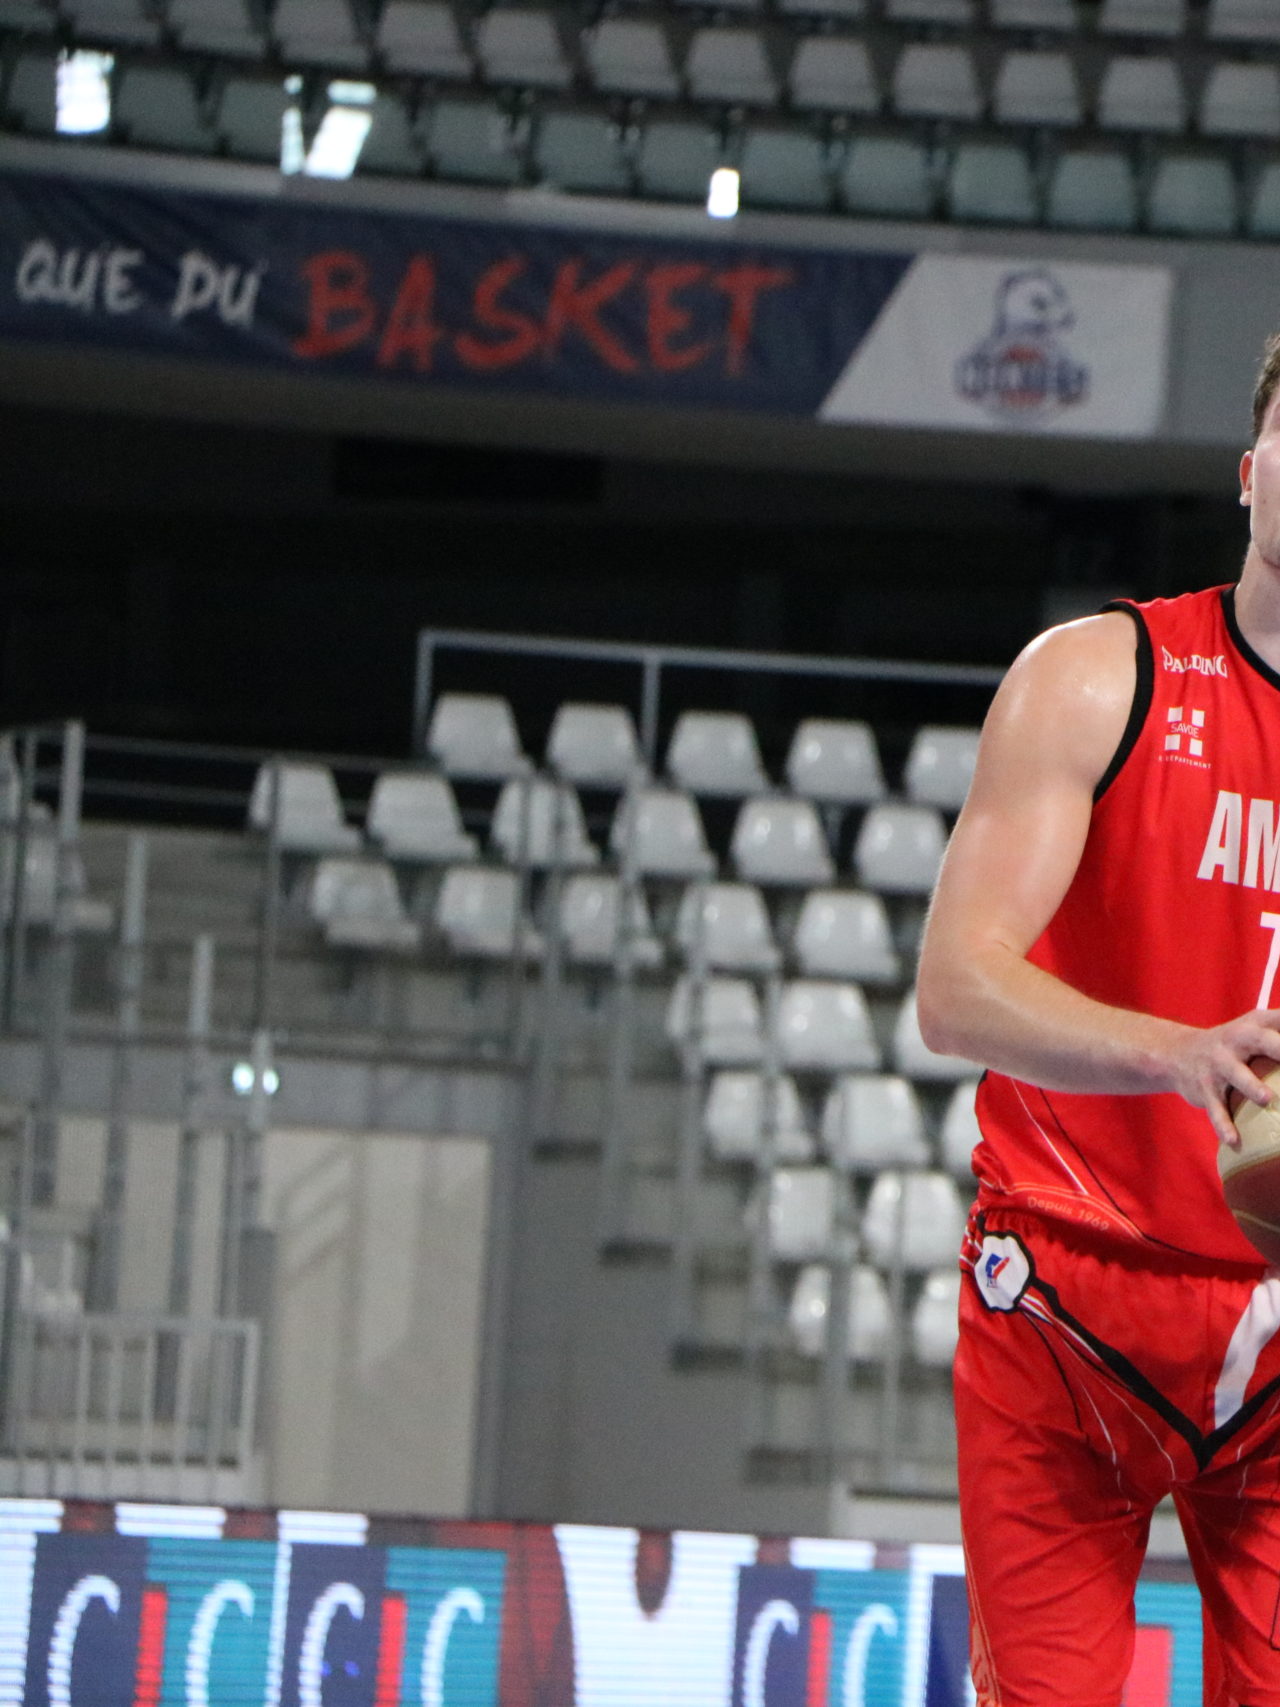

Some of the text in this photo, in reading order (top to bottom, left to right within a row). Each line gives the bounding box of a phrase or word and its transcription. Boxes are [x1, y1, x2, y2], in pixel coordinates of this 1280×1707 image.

[15, 238, 793, 378] QUE DU BASKET
[1161, 645, 1228, 678] PALDING
[1027, 1196, 1073, 1215] Depuis
